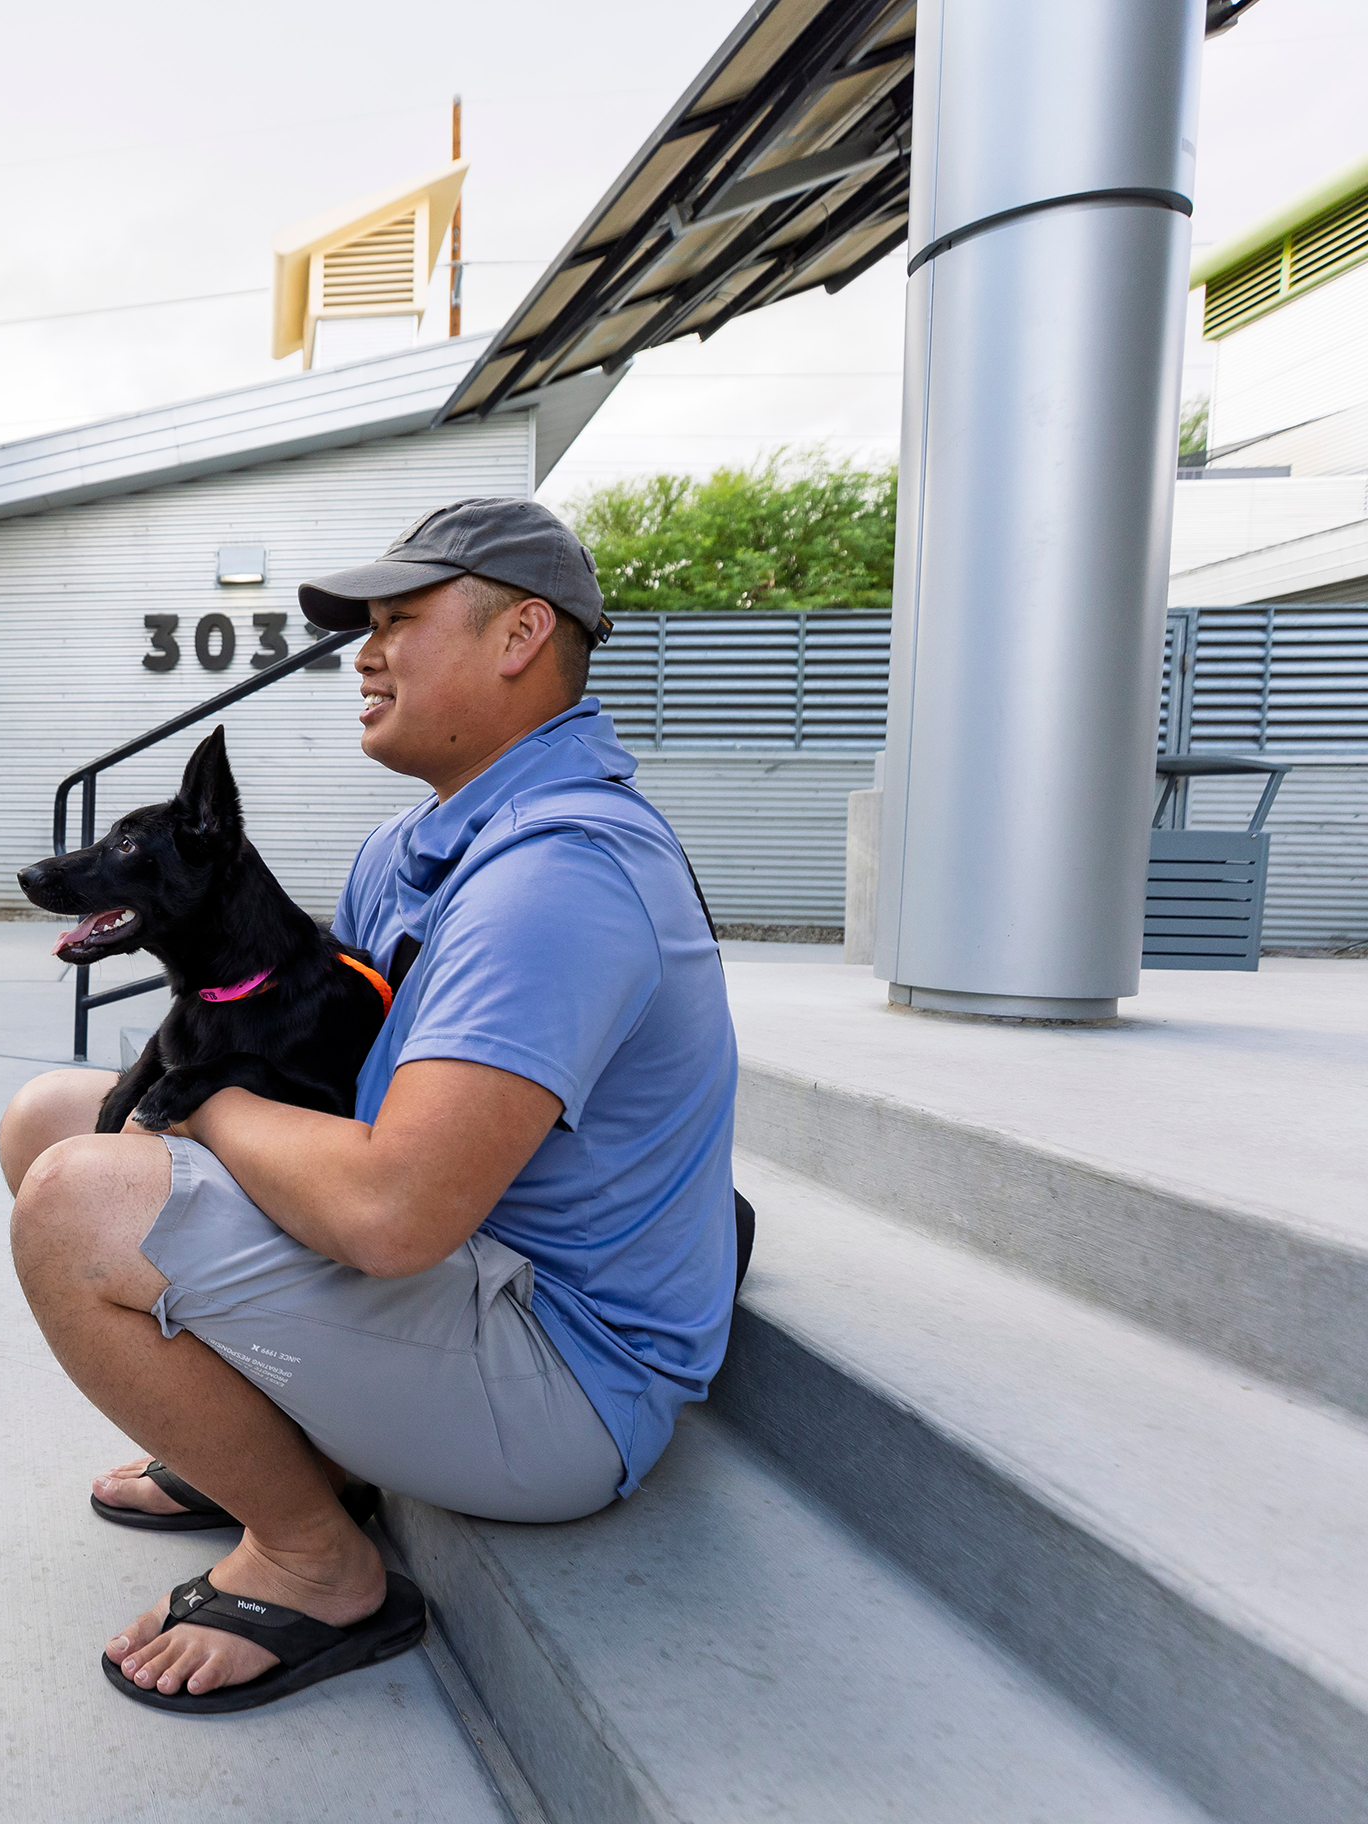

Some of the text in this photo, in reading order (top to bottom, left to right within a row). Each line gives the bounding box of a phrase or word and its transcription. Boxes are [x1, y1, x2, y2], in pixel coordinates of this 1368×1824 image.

[278, 1352, 302, 1364] SINCE
[251, 1359, 293, 1379] OPERATING
[237, 1599, 267, 1615] Hurley
